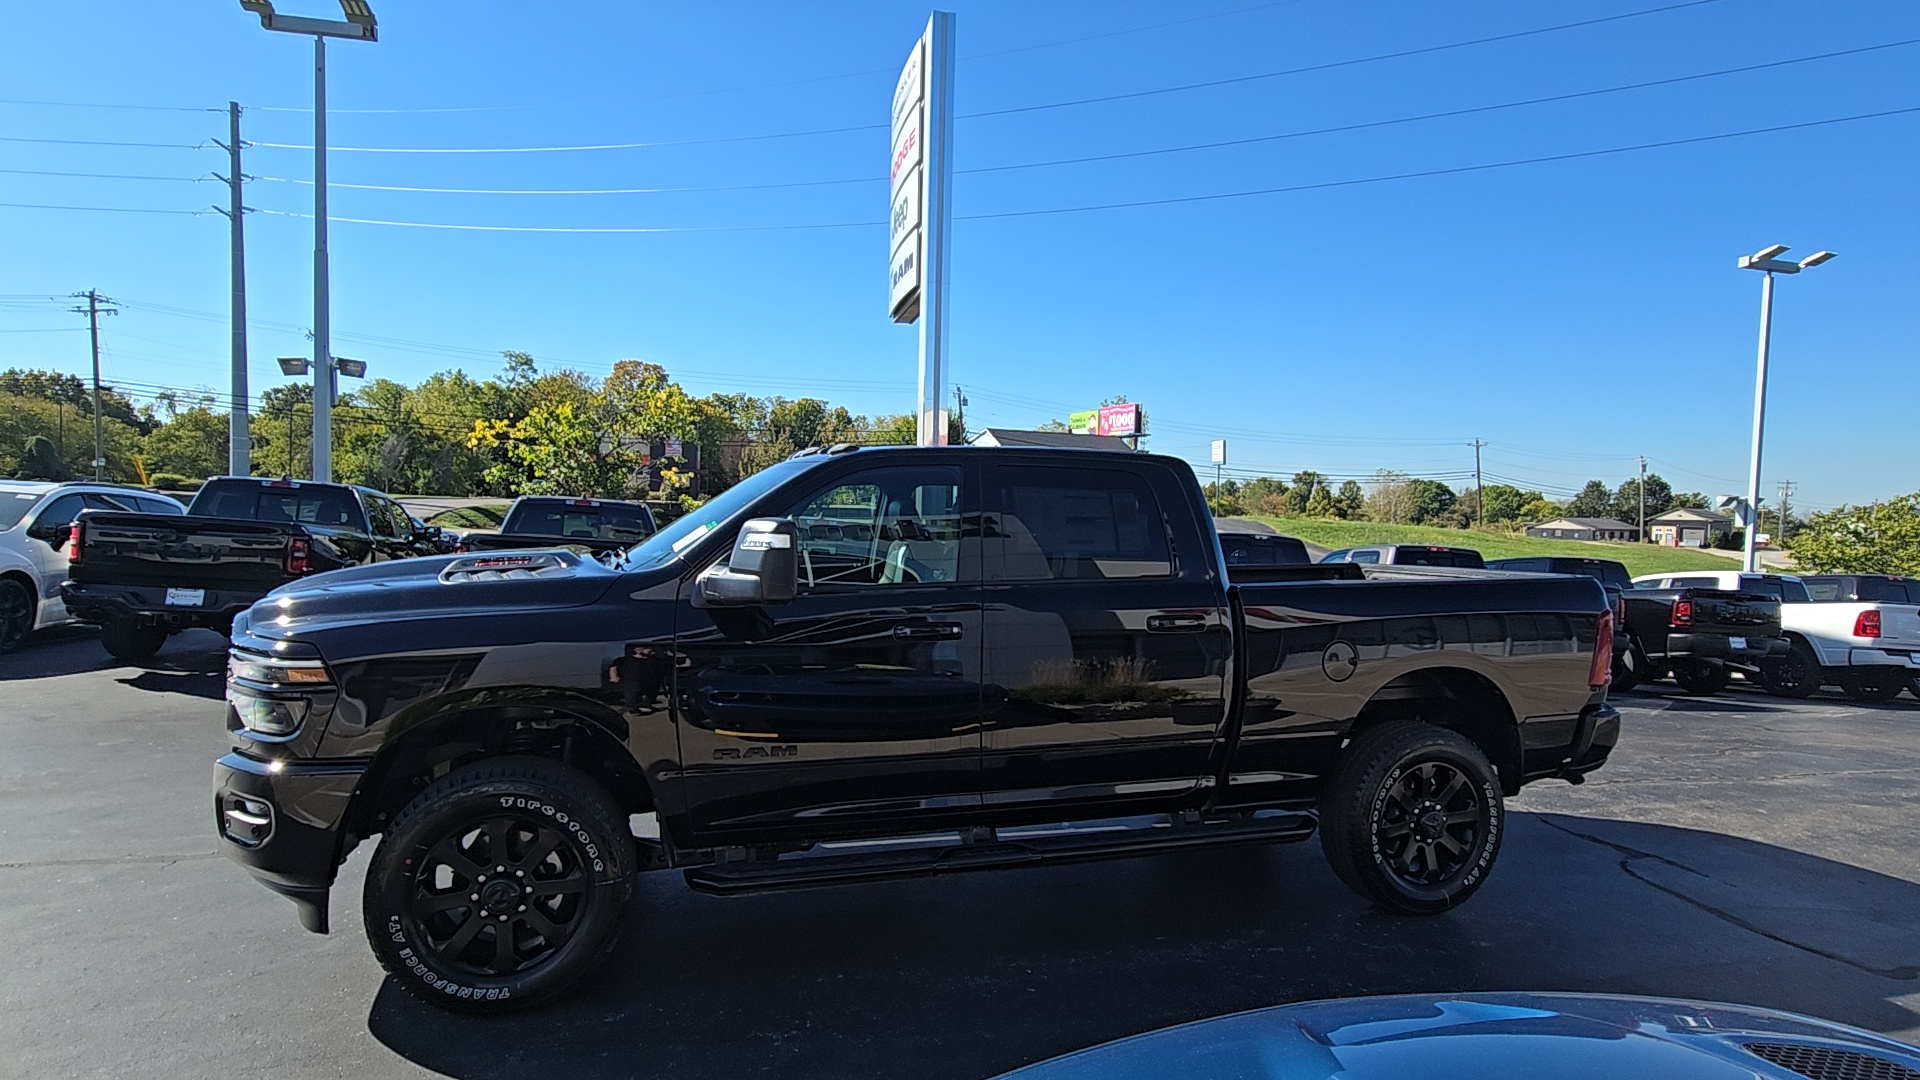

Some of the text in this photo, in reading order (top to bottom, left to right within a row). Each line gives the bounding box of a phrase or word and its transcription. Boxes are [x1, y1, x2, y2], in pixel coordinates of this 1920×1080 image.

[893, 252, 914, 289] RAM
[713, 745, 798, 760] RAM
[399, 947, 511, 1000] TRANSFORCE
